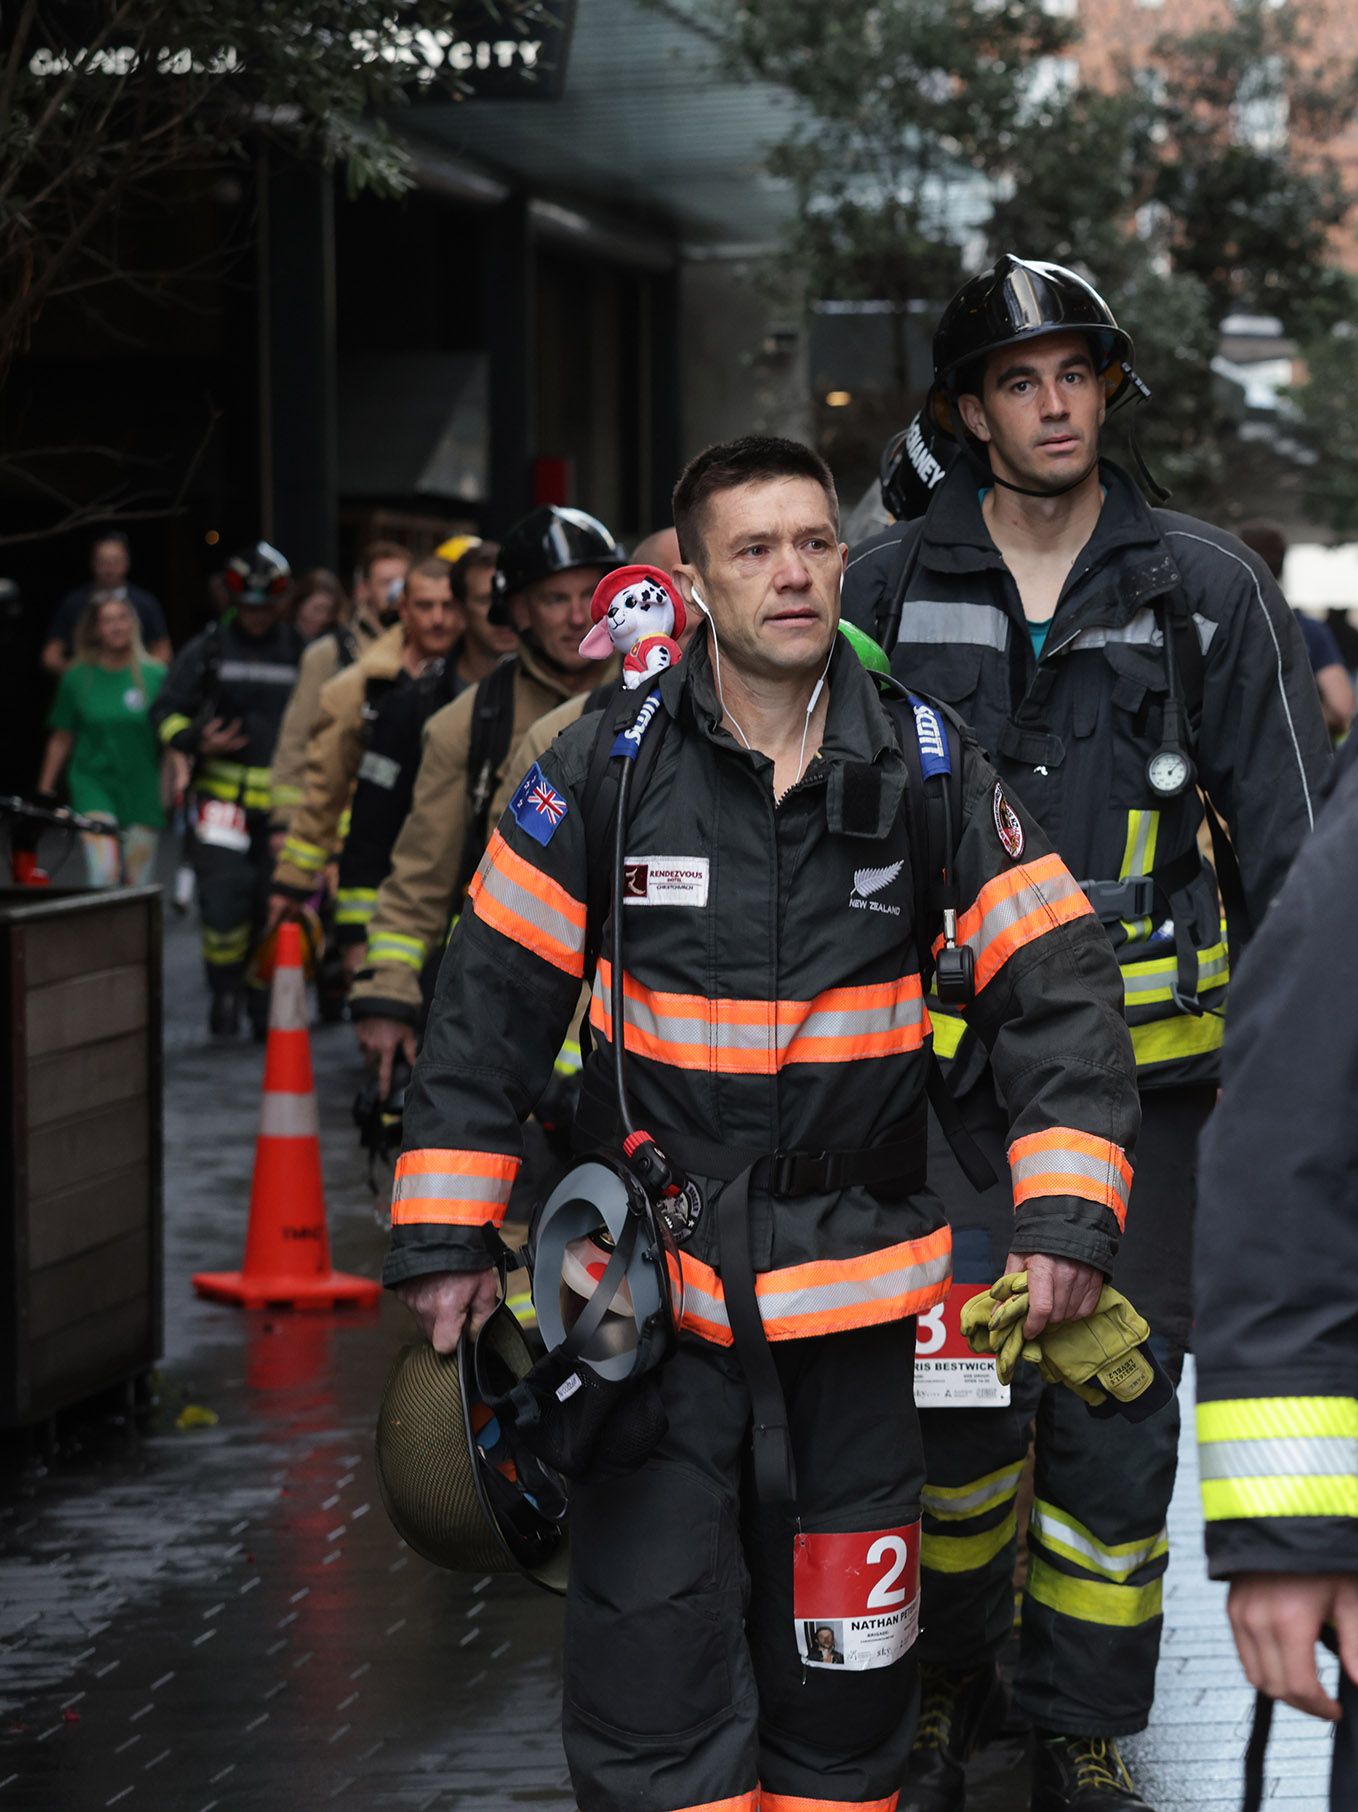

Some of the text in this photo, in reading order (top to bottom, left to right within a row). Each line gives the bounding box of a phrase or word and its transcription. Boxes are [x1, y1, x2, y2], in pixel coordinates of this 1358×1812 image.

[913, 705, 945, 757] SCOTT
[649, 870, 703, 879] RENDEZVOUS
[849, 898, 901, 916] NEW ZEALAND
[935, 1362, 995, 1371] BESTWICK
[866, 1535, 908, 1609] 2
[851, 1615, 899, 1631] NATHAN
